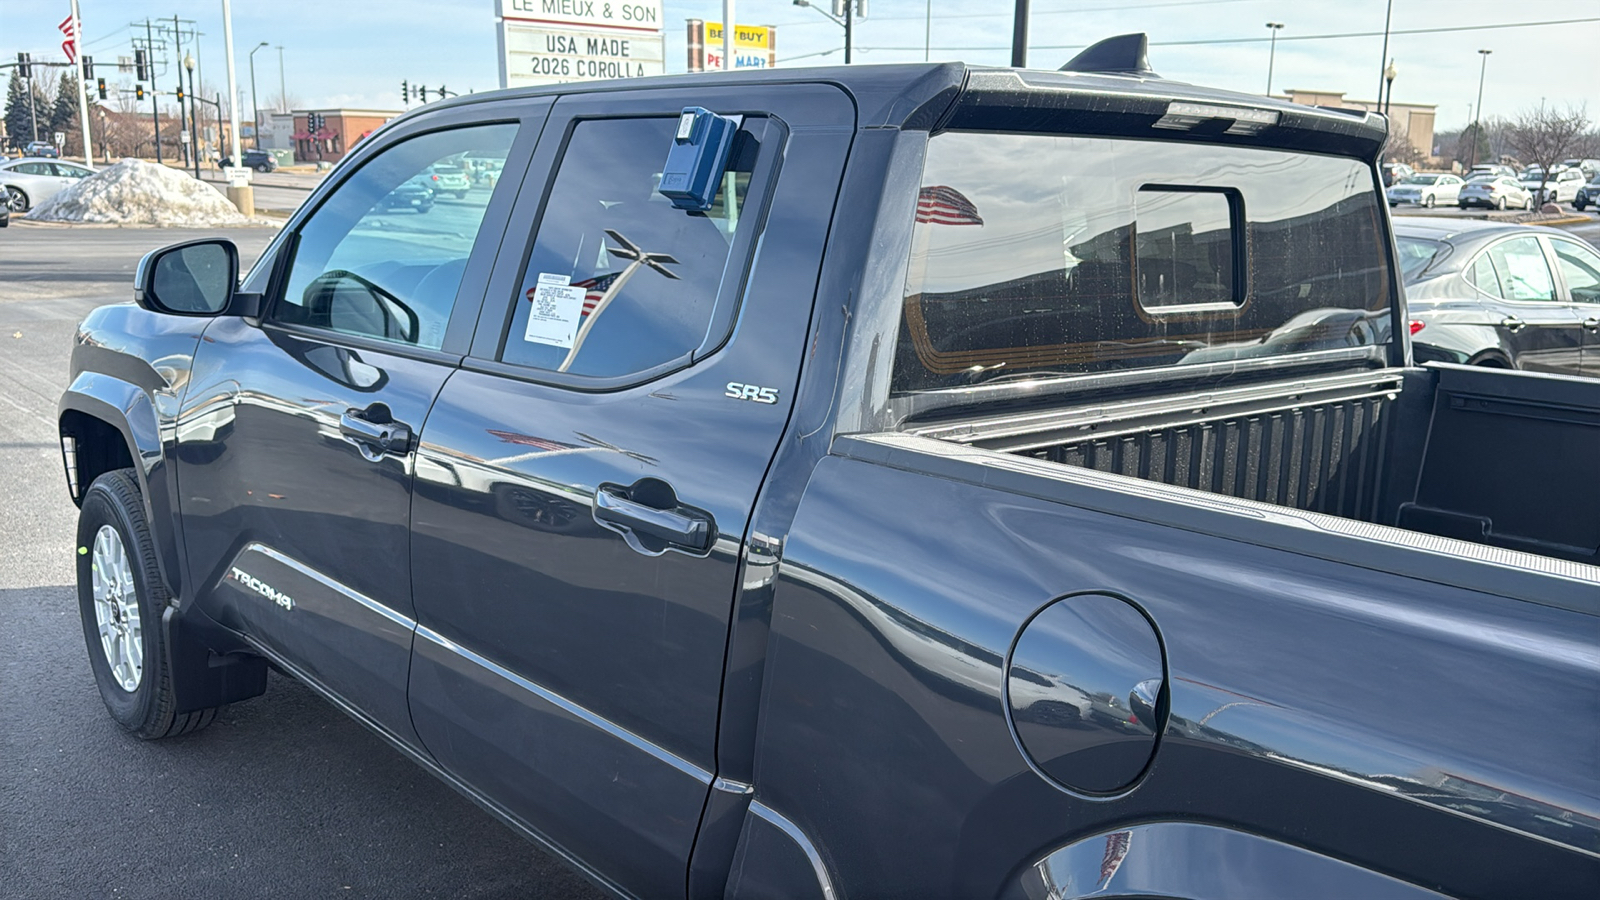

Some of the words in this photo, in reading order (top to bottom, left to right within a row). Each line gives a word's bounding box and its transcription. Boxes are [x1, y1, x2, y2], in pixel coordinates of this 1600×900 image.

[513, 0, 533, 12] LE
[542, 0, 595, 17] MIEUX
[602, 2, 613, 19] &
[622, 4, 656, 22] SON
[546, 34, 577, 54] USA
[587, 37, 630, 57] MADE
[740, 31, 763, 42] BUY
[531, 56, 570, 75] 2026
[576, 59, 644, 78] COROLLA
[725, 381, 779, 404] SR5
[231, 566, 292, 611] TACOMA
